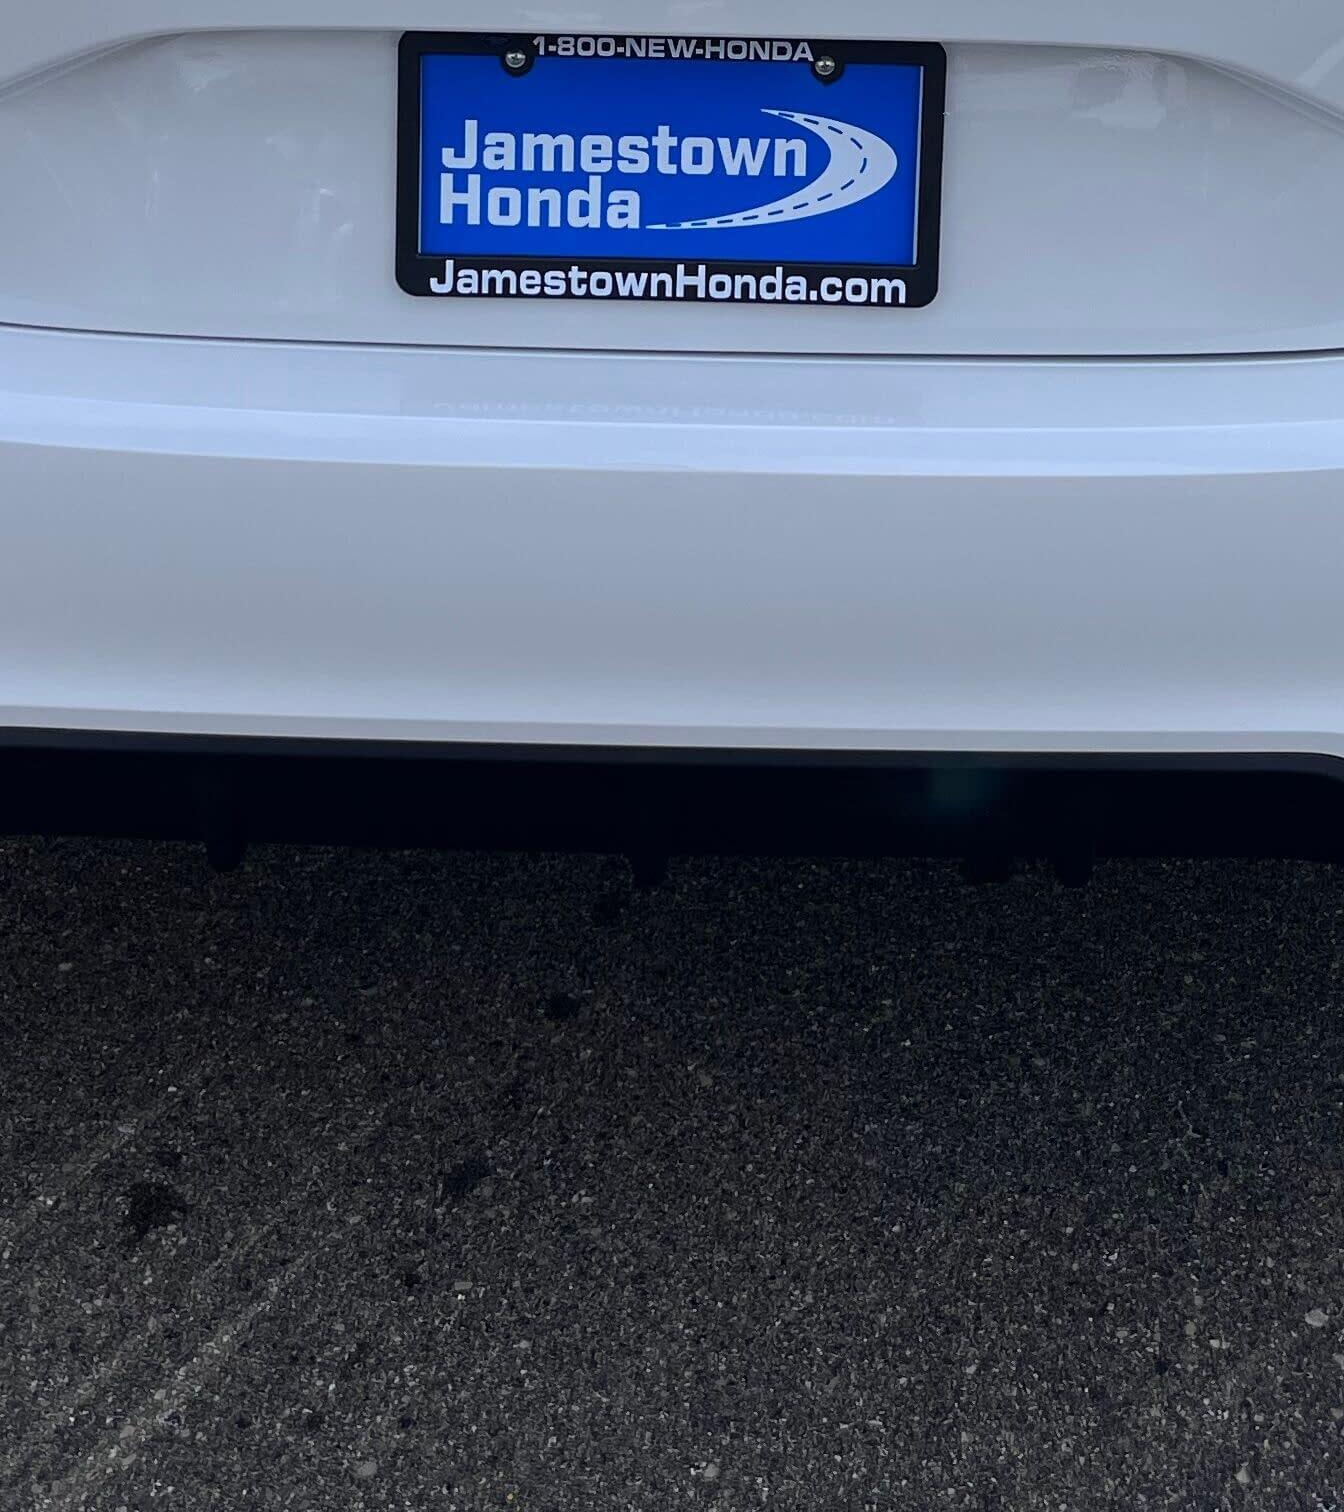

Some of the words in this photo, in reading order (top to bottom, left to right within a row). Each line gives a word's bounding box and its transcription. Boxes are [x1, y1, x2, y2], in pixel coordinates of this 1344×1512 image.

[532, 36, 815, 62] 1-800-NEW-HONDA
[441, 119, 807, 177] Jamestown
[439, 173, 641, 230] Honda
[429, 259, 907, 305] JamestownHonda.com
